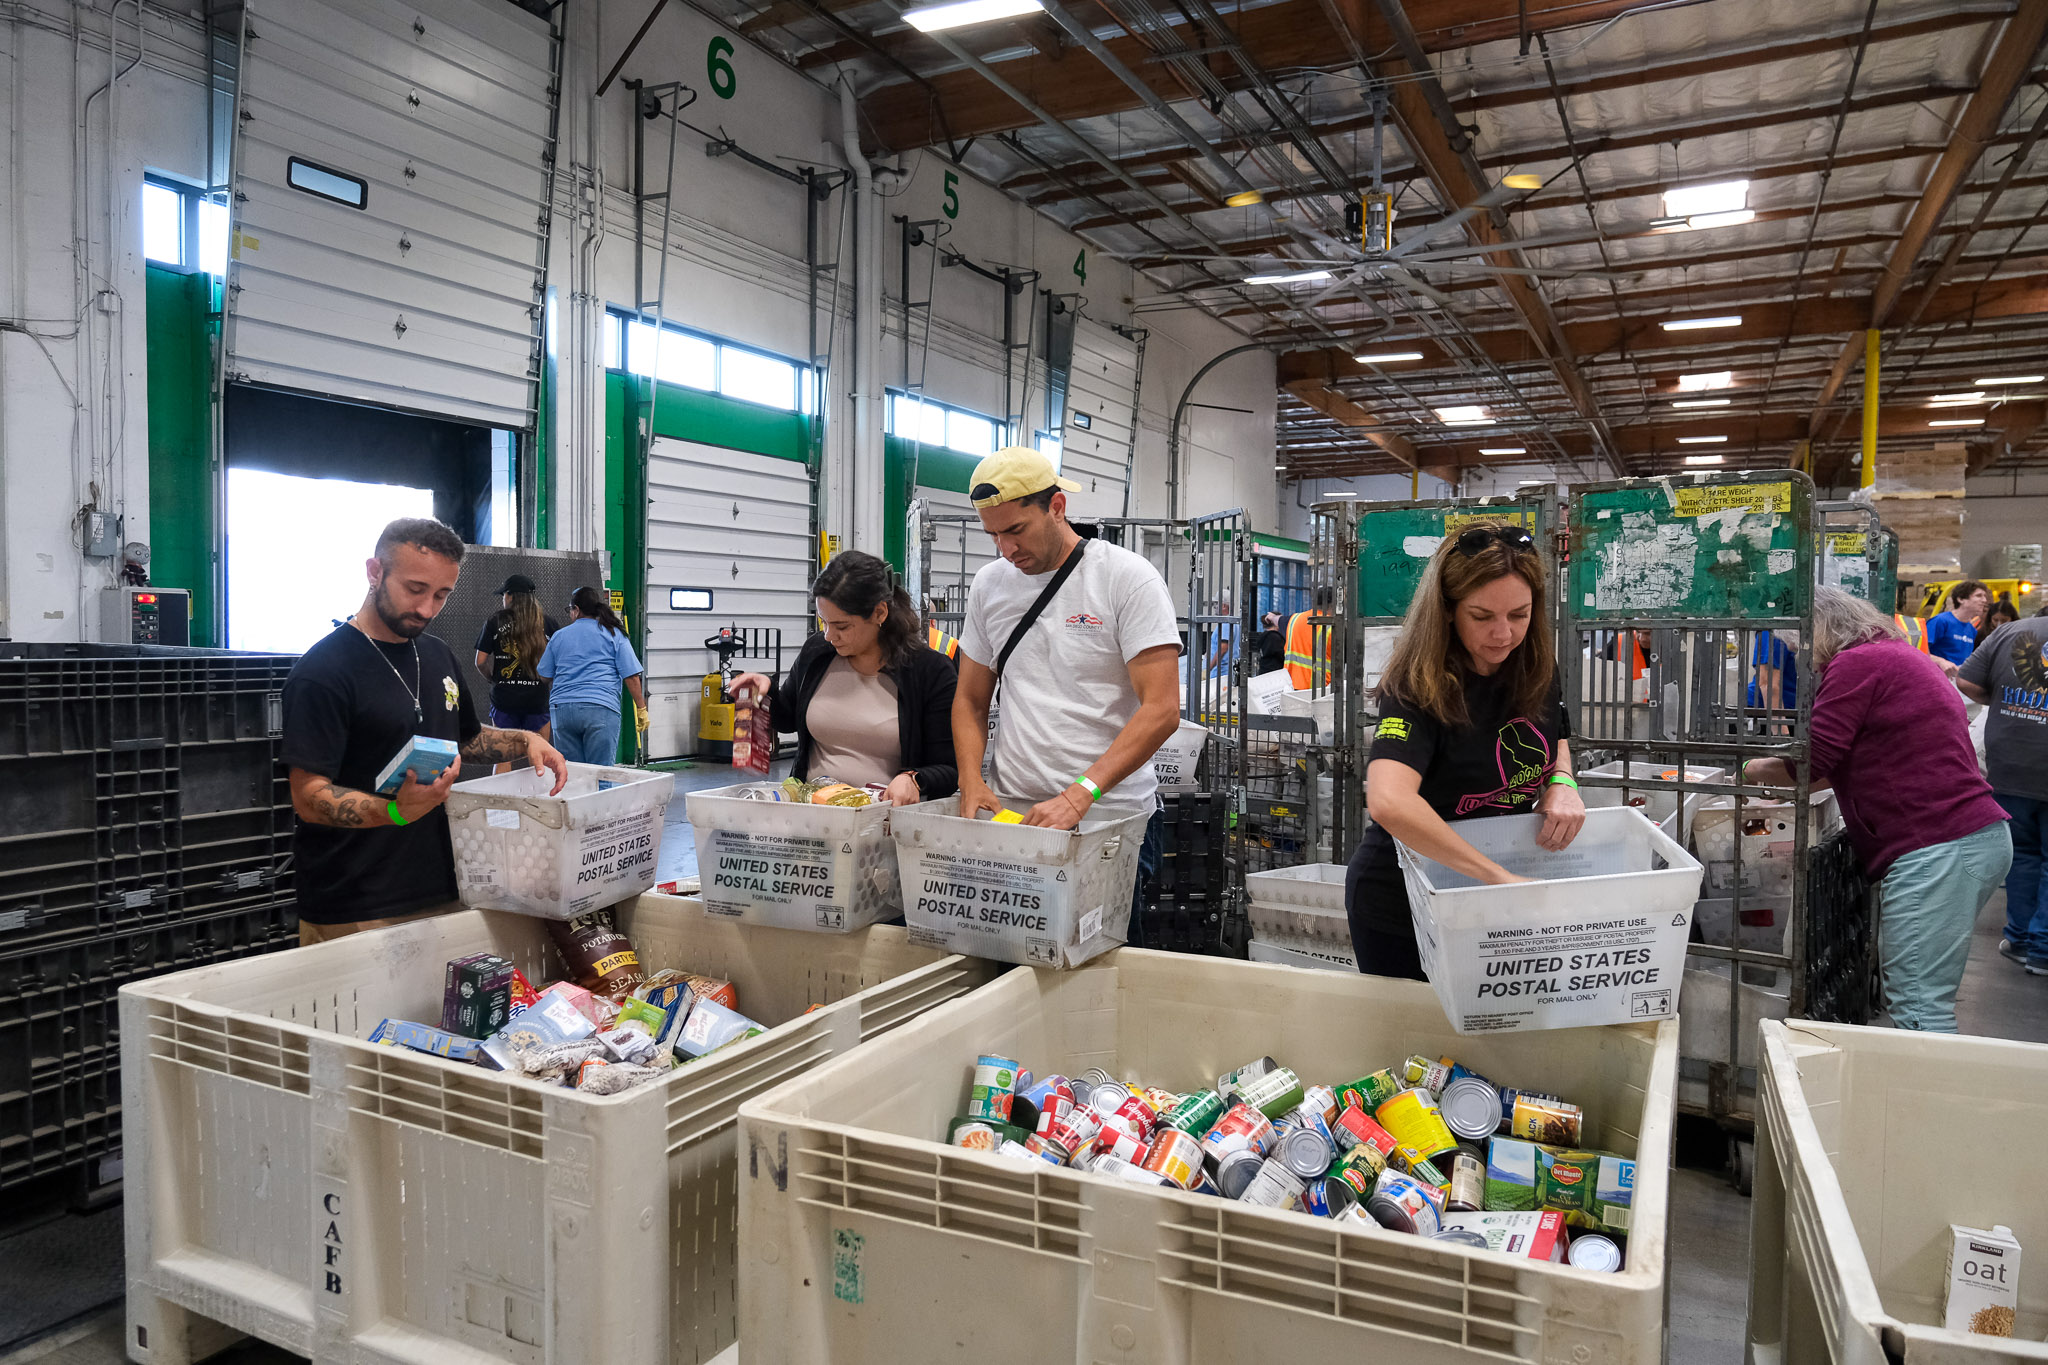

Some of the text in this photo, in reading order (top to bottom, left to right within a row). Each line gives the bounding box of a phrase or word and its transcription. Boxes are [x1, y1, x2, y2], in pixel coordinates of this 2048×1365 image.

[707, 35, 737, 99] 6
[942, 169, 959, 219] 5
[1073, 248, 1087, 287] 4
[1382, 561, 1410, 577] 199
[1154, 764, 1179, 773] ATES
[1156, 775, 1181, 784] VICE
[617, 818, 626, 826] FOR
[626, 814, 642, 823] PRIVATE
[721, 832, 750, 840] WARNING
[784, 838, 810, 846] PRIVATE
[582, 834, 651, 865] UNITED STATES
[577, 863, 614, 884] POSTAL
[617, 849, 653, 871] SERVICE
[719, 857, 829, 880] UNITED STATES
[925, 852, 1038, 874] WARNING NOT FOR PRIVATE USE
[714, 874, 835, 899] POSTAL SERVICE
[923, 879, 1041, 910] UNITED STATES
[917, 898, 1047, 931] POSTAL SERVICE
[957, 921, 970, 929] FOR
[984, 926, 1000, 935] ONLY
[1488, 918, 1647, 939] WARNING NOT FOR PRIVATE USE
[1625, 929, 1655, 937] PROPERTY
[581, 933, 616, 952] POTATO
[1561, 940, 1603, 949] IMPRISONMENT
[601, 956, 629, 971] PARTY
[1485, 948, 1652, 977] UNITED STATES
[609, 974, 634, 992] SEA
[1477, 967, 1660, 999] POSTAL SERVICE
[1537, 993, 1598, 1005] FOR MAIL ONLY
[1528, 1118, 1537, 1138] LACK
[1563, 1170, 1581, 1178] Monte
[1622, 1165, 1635, 1178] 12
[1548, 1195, 1565, 1204] GREEN
[1540, 1218, 1556, 1230] CANS
[1971, 1243, 2003, 1254] KIRKLAND
[1963, 1260, 2007, 1283] oat
